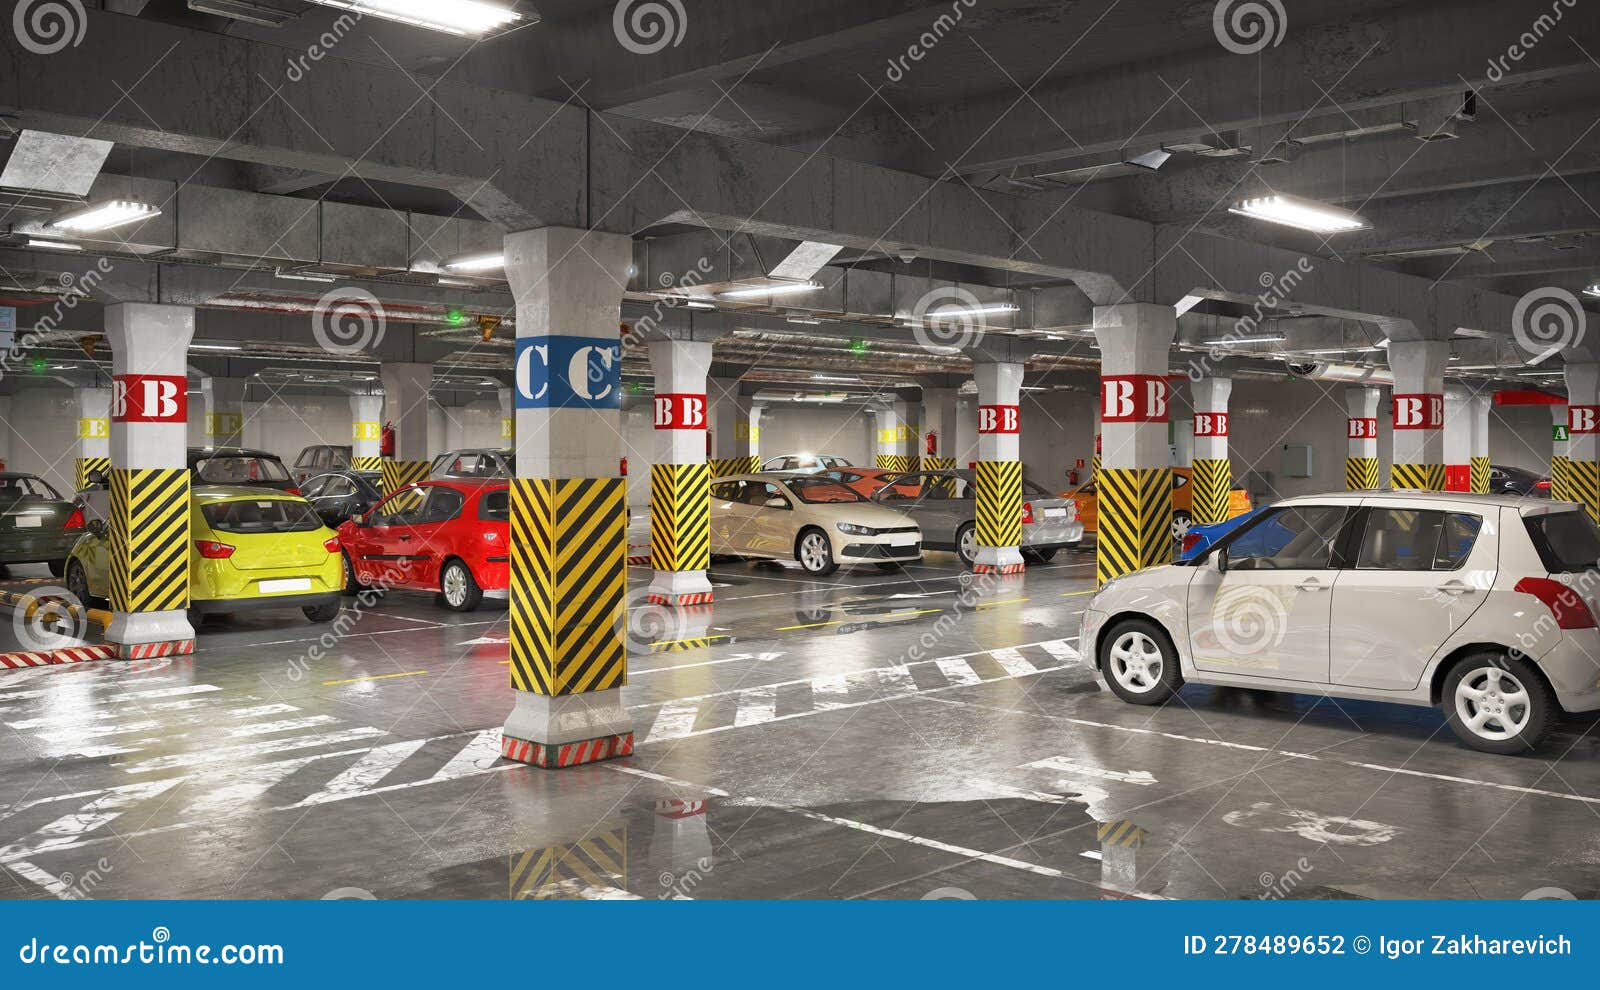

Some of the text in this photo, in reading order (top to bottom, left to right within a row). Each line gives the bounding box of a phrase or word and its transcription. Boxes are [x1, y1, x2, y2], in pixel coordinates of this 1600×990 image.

[516, 344, 612, 400] C C
[113, 380, 178, 417] B B
[1104, 380, 1166, 417] B B
[655, 398, 703, 425] B B
[979, 408, 1018, 431] B B
[1396, 398, 1442, 425] B B
[1571, 408, 1595, 431] B
[90, 420, 105, 437] E
[365, 423, 378, 438] E
[1195, 415, 1227, 434] B B
[1349, 420, 1376, 436] B B
[1555, 426, 1567, 440] A
